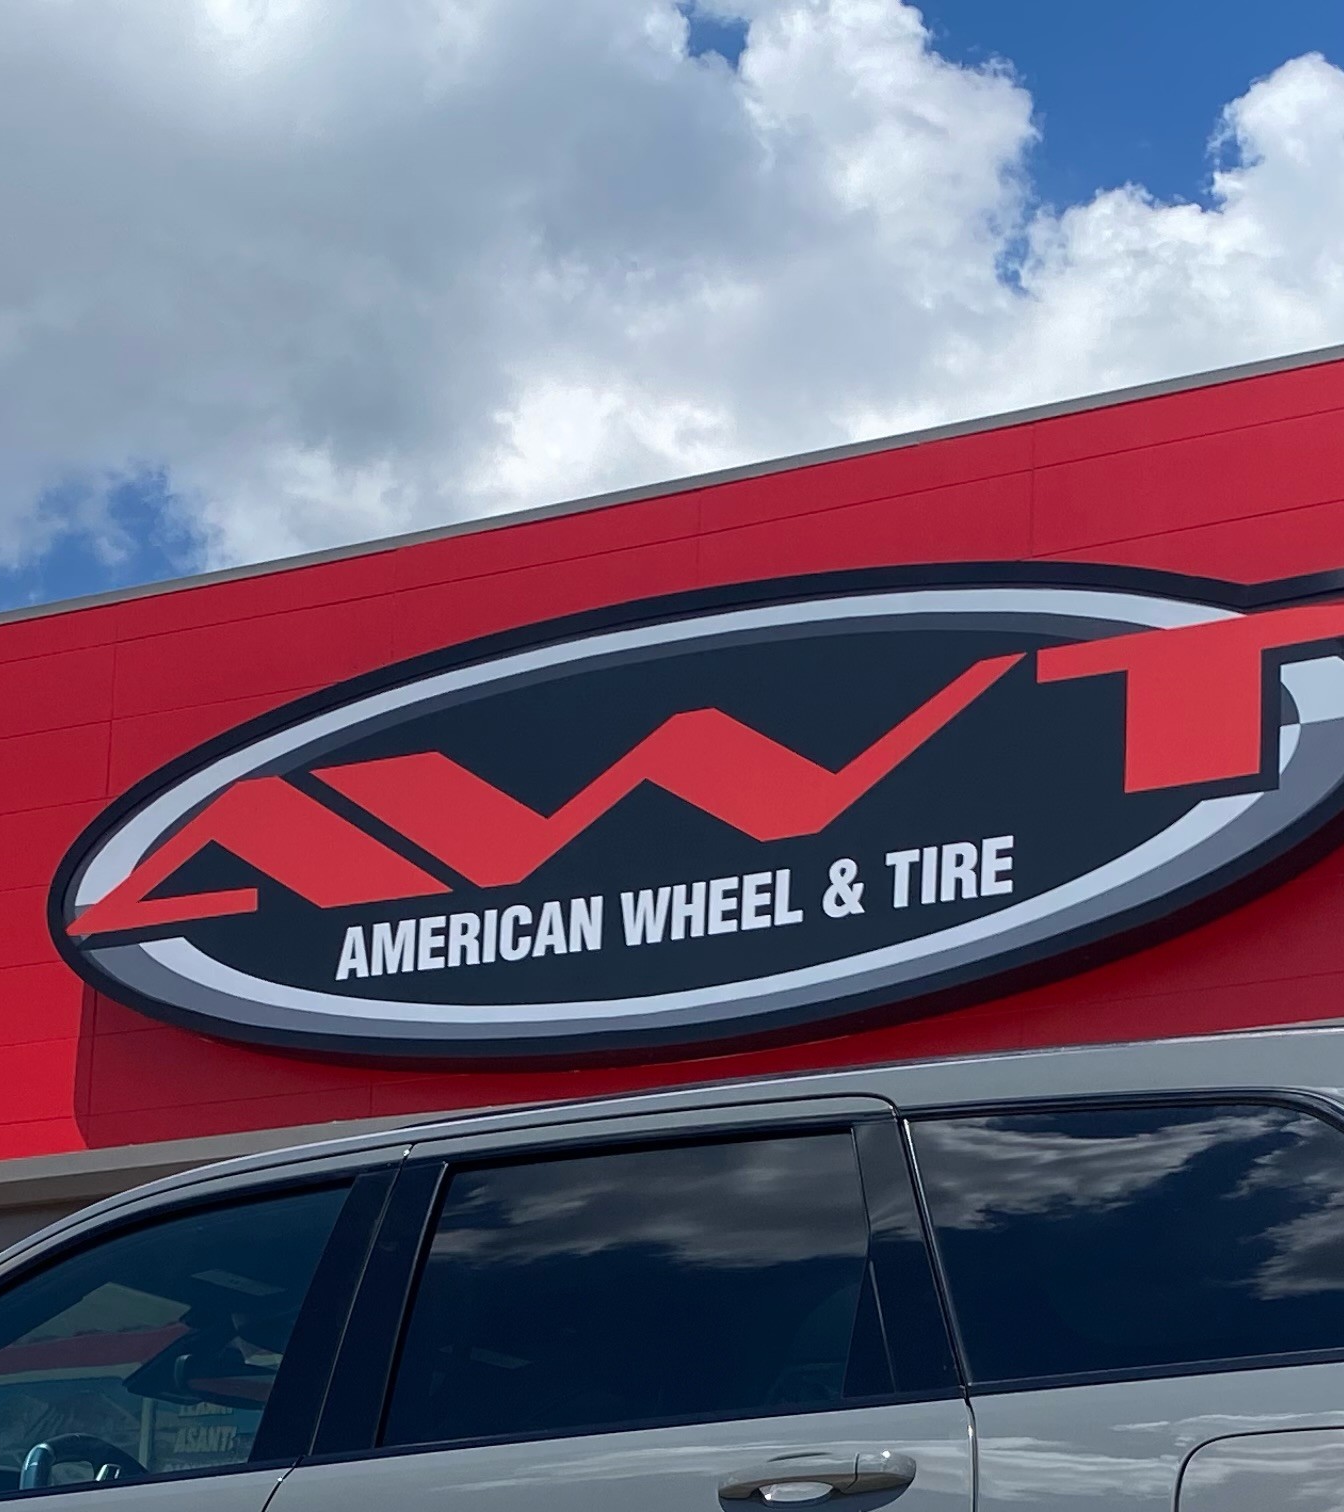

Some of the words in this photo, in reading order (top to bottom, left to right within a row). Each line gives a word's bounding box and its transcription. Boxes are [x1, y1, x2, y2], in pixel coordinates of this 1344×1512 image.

[335, 895, 603, 981] AMERICAN
[620, 868, 803, 946] WHEEL
[822, 858, 865, 918] &
[886, 835, 1015, 908] TIRE
